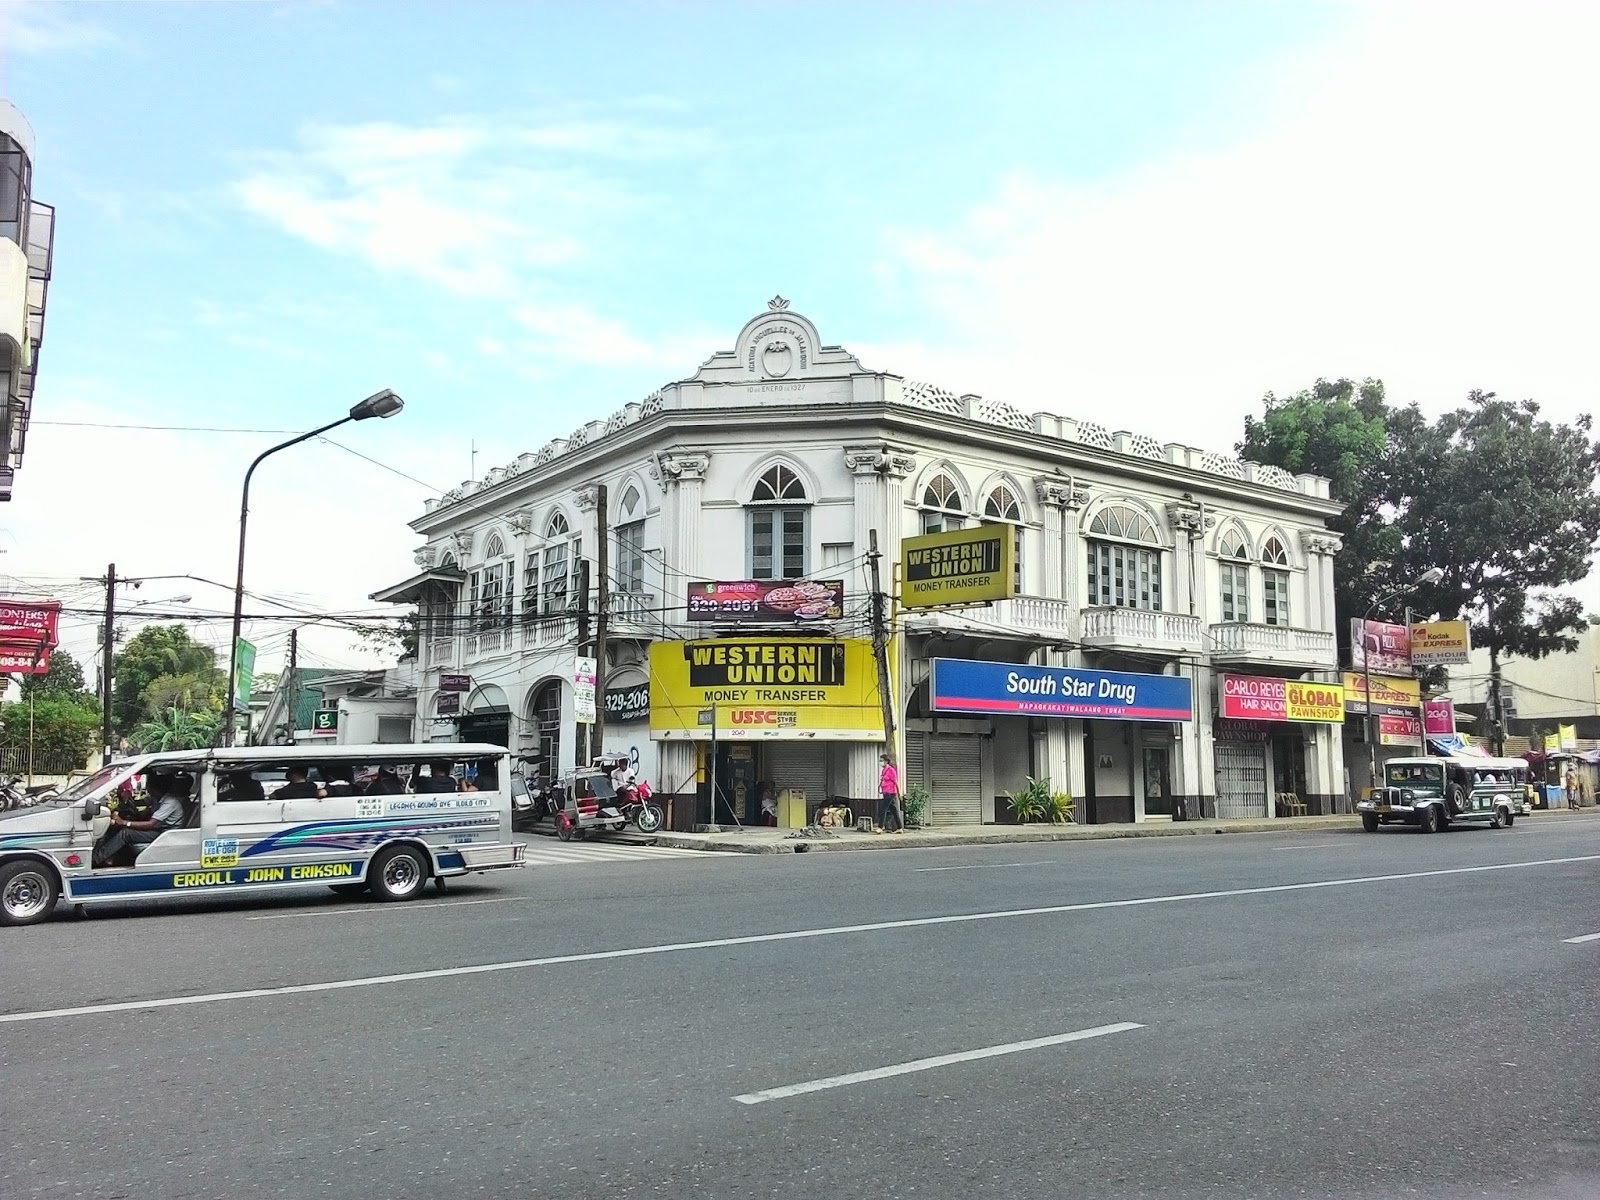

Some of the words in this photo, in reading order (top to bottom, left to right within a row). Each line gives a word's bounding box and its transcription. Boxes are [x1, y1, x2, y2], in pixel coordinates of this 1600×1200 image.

[761, 385, 783, 393] ENERO
[908, 542, 982, 565] WESTERN
[930, 558, 982, 577] UNION
[717, 583, 757, 593] greenwich
[914, 581, 943, 593] MONEY
[945, 576, 991, 590] TRANSFER
[0, 608, 50, 620] ONTEREY
[1423, 639, 1463, 648] EXPRESS
[693, 645, 816, 666] WESTERN
[1413, 652, 1437, 660] ONE
[1439, 651, 1467, 659] HOUR
[727, 665, 815, 684] UNION
[1006, 671, 1057, 696] South
[1062, 676, 1096, 698] Star
[1099, 678, 1136, 704] Drug
[1224, 679, 1259, 696] CARLO
[1260, 682, 1285, 698] REYES
[605, 690, 651, 711] 329-206
[704, 690, 748, 702] MONEY
[755, 690, 827, 701] TRANSFER
[1288, 689, 1342, 708] GLOBAL
[1375, 691, 1411, 702] EXPRESS
[1240, 698, 1259, 710] HAIR
[1260, 700, 1287, 712] SALON
[731, 710, 777, 724] USSC
[1291, 706, 1340, 719] PAWNSHOP
[1387, 708, 1405, 717] Center,
[1220, 720, 1260, 731] GLOBAL
[1214, 731, 1268, 742] PAWNSHOP
[173, 871, 236, 888] ERROLL
[244, 868, 285, 883] JOHN
[291, 863, 352, 880] ERIKSON
